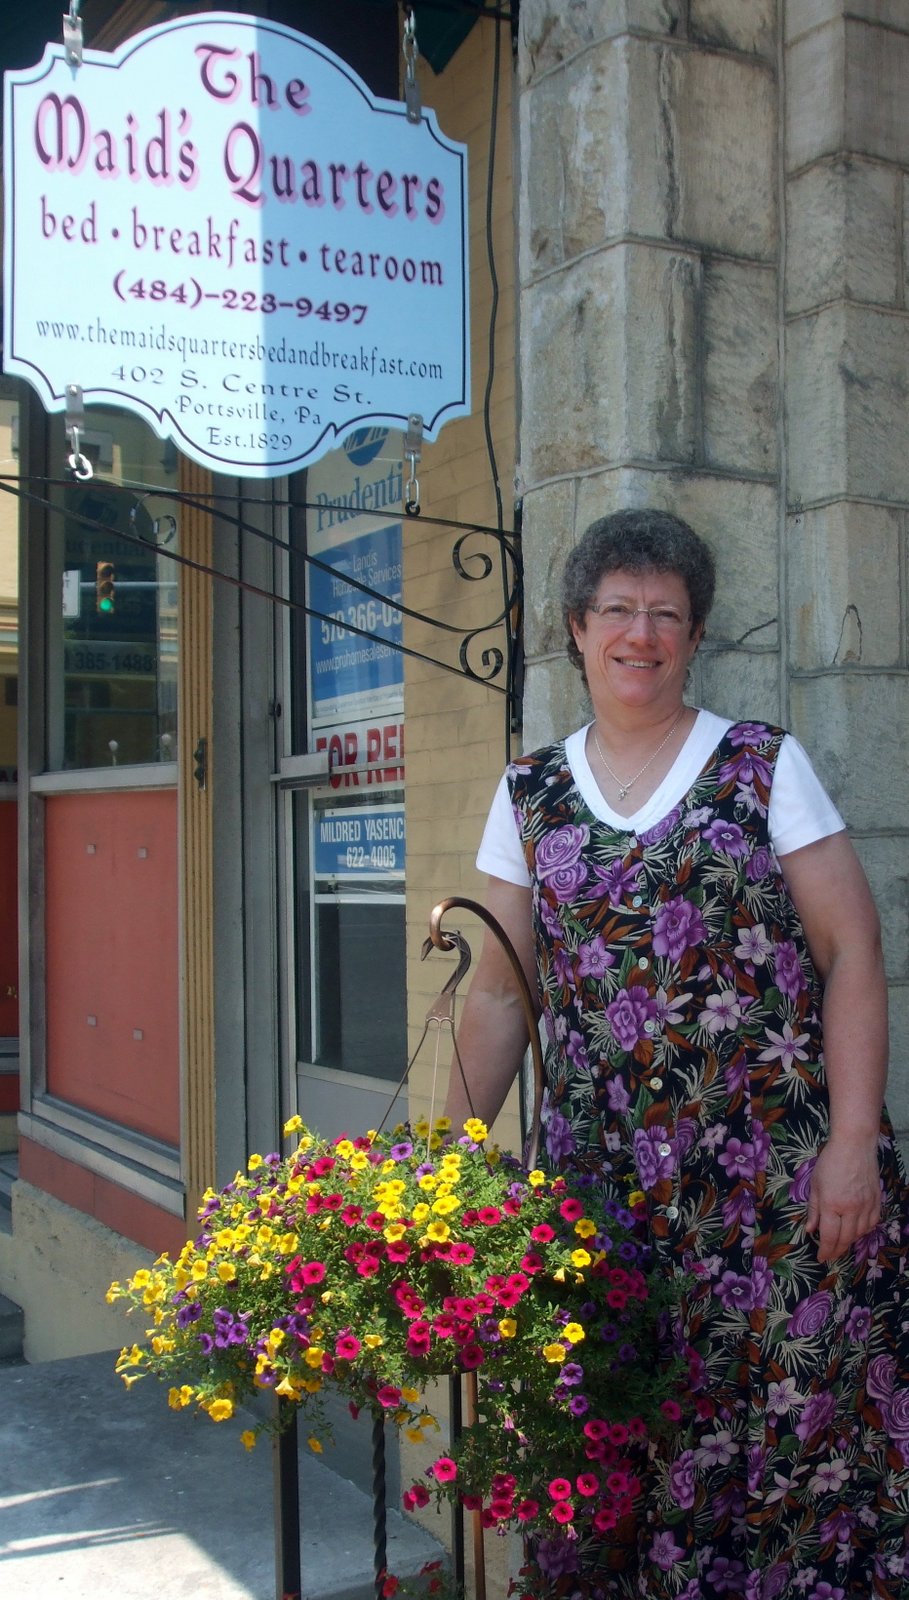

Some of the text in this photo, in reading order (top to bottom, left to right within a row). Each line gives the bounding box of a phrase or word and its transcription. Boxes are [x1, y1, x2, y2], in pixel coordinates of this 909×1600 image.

[194, 43, 310, 113] The
[34, 92, 444, 222] Maid's Quarters
[41, 194, 443, 285] bed breakfast tearoom
[113, 269, 368, 324] (484)-223-9497
[36, 317, 443, 379] www.themaidsquartersbedandbreakfast.com
[111, 365, 372, 405] 402 S. Centre St.
[175, 394, 321, 425] Pottsville, Pa
[206, 427, 292, 451] Est.1829
[368, 563, 402, 586] Services
[321, 610, 345, 645] 570
[367, 724, 405, 784] RE
[320, 817, 405, 843] MILDRED YASENC
[346, 845, 396, 869] 622-4005
